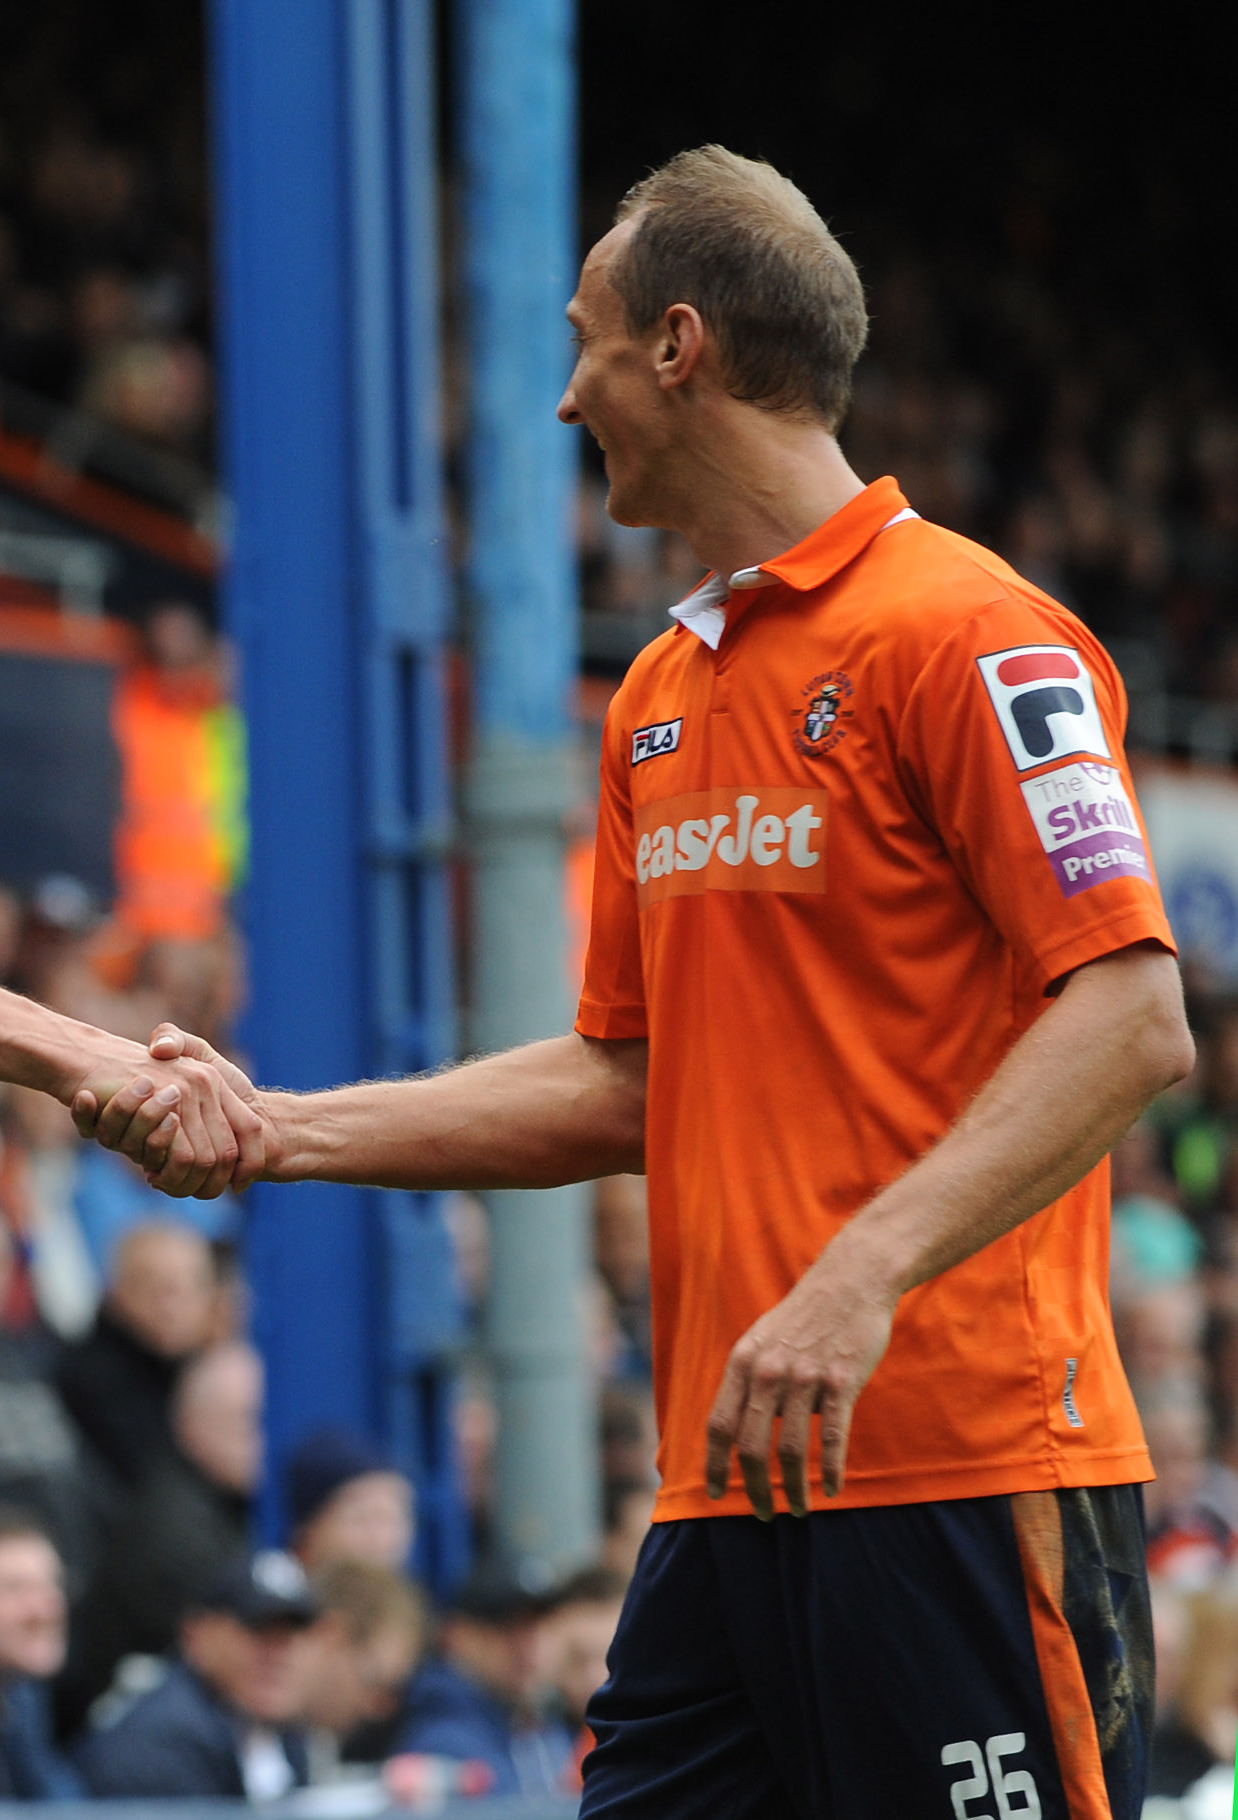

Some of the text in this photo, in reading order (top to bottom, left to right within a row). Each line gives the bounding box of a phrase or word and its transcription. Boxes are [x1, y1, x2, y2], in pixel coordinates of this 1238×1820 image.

[636, 727, 675, 759] FILA
[1034, 777, 1084, 802] The
[1047, 795, 1135, 841] Skrill
[940, 1731, 1043, 1820] 26
